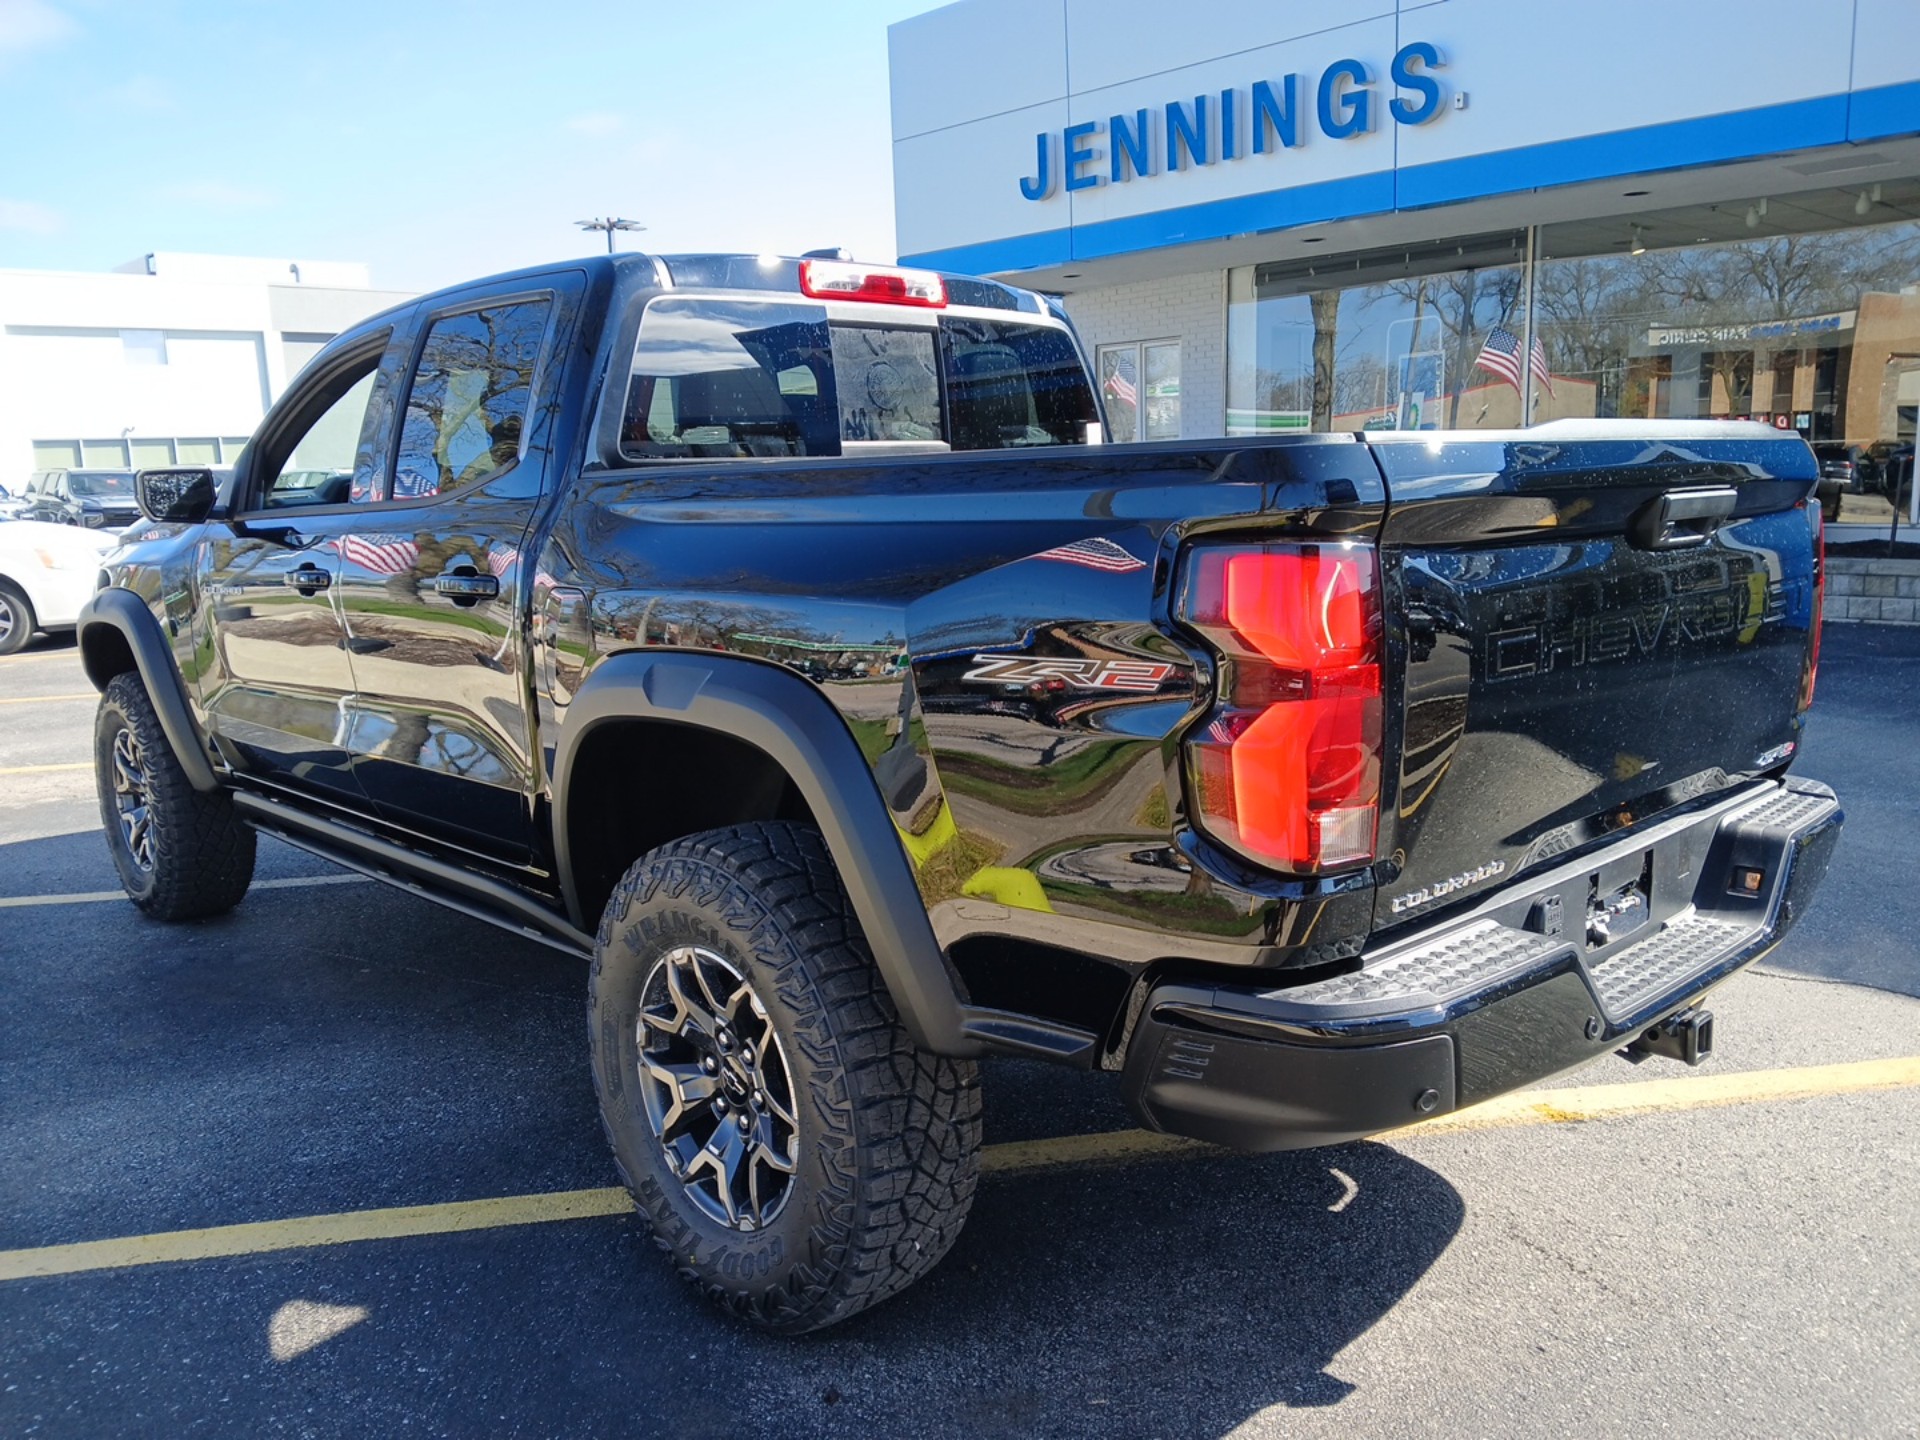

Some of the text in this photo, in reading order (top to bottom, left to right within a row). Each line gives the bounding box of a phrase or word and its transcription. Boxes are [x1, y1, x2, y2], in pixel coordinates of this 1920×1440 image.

[1019, 41, 1447, 201] JENNINGS
[961, 653, 1176, 692] ZR2
[1391, 859, 1505, 913] COLORADO
